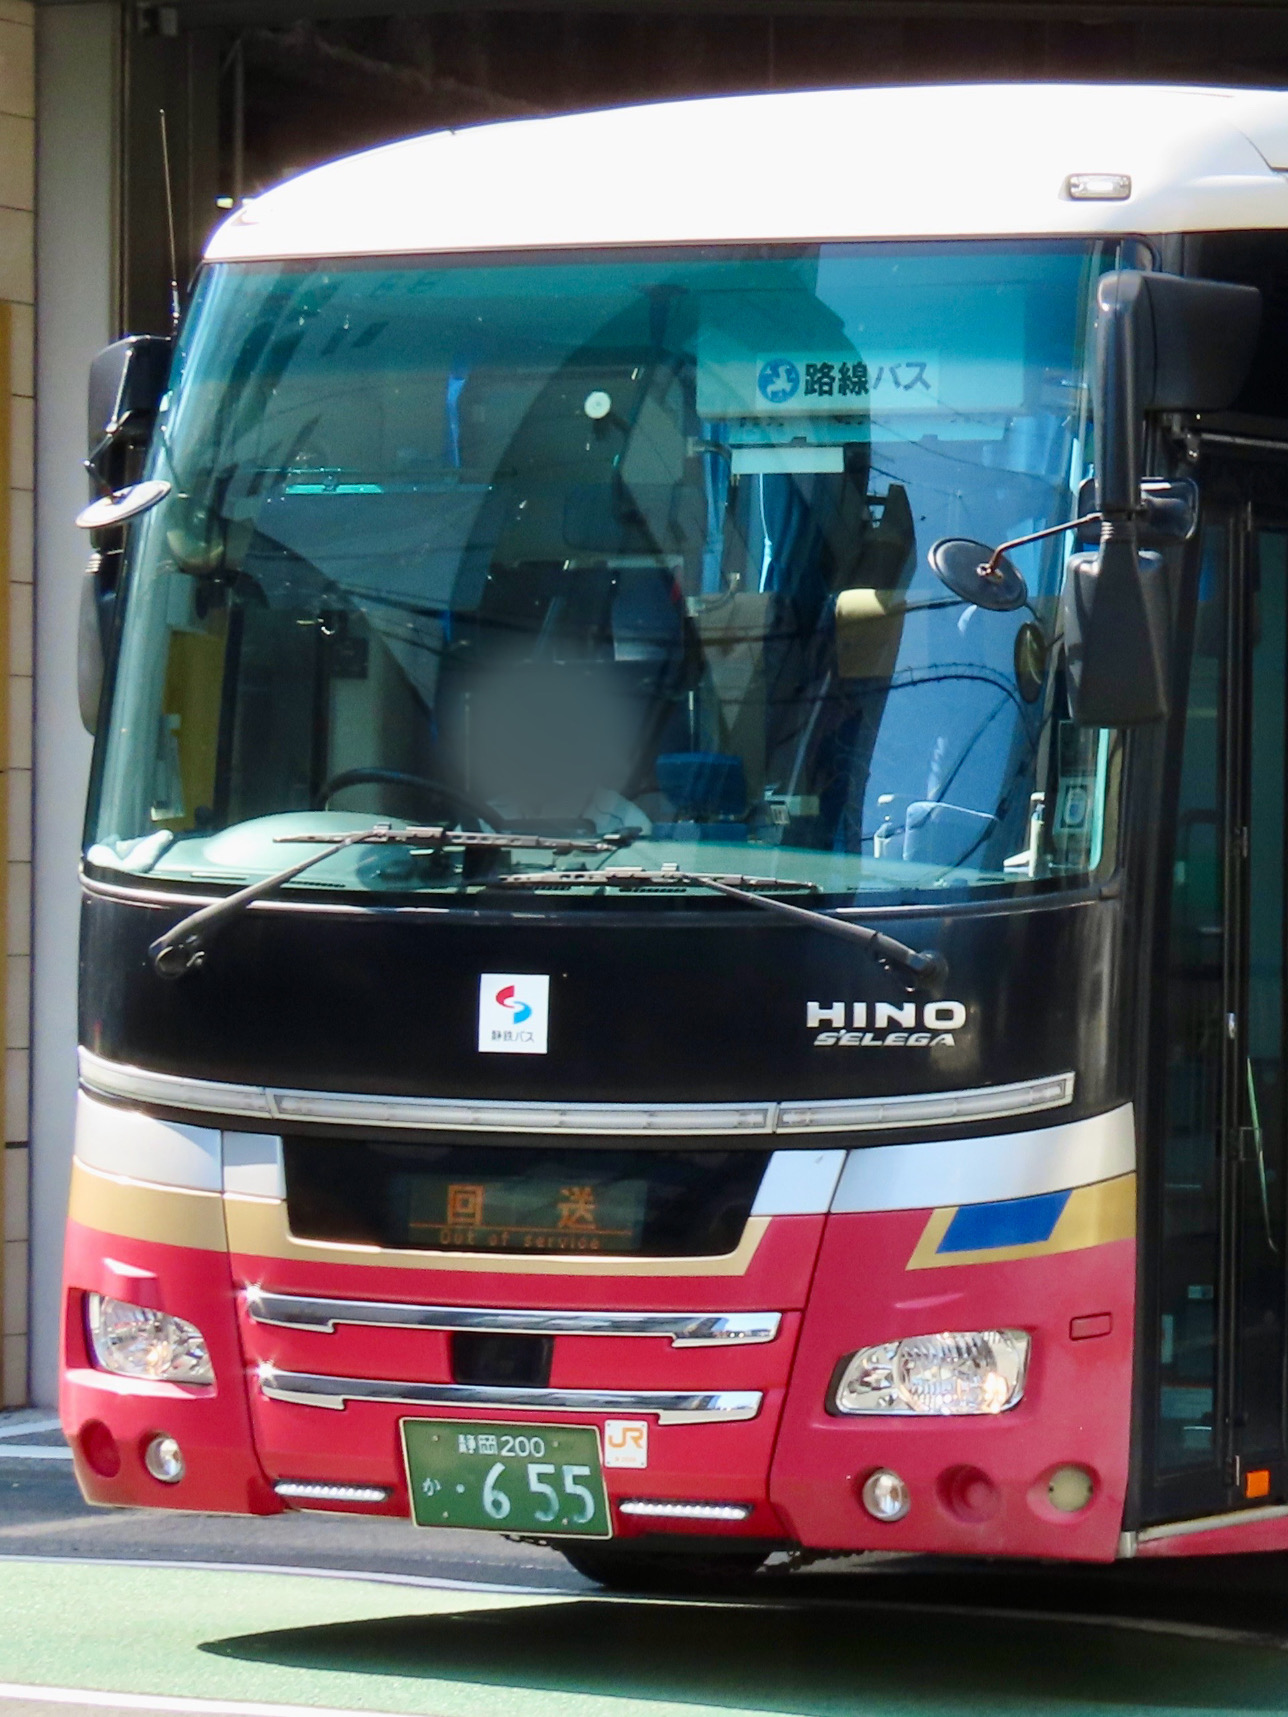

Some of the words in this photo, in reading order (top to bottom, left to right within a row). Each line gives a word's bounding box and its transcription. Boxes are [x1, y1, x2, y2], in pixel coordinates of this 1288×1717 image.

[804, 361, 931, 397] 路線バス
[806, 1001, 967, 1030] HINO
[491, 1029, 536, 1043] 静鉄バス
[440, 1229, 475, 1245] Out
[488, 1231, 510, 1247] of
[524, 1234, 600, 1250] service
[608, 1426, 645, 1450] JR
[421, 1477, 442, 1497] か
